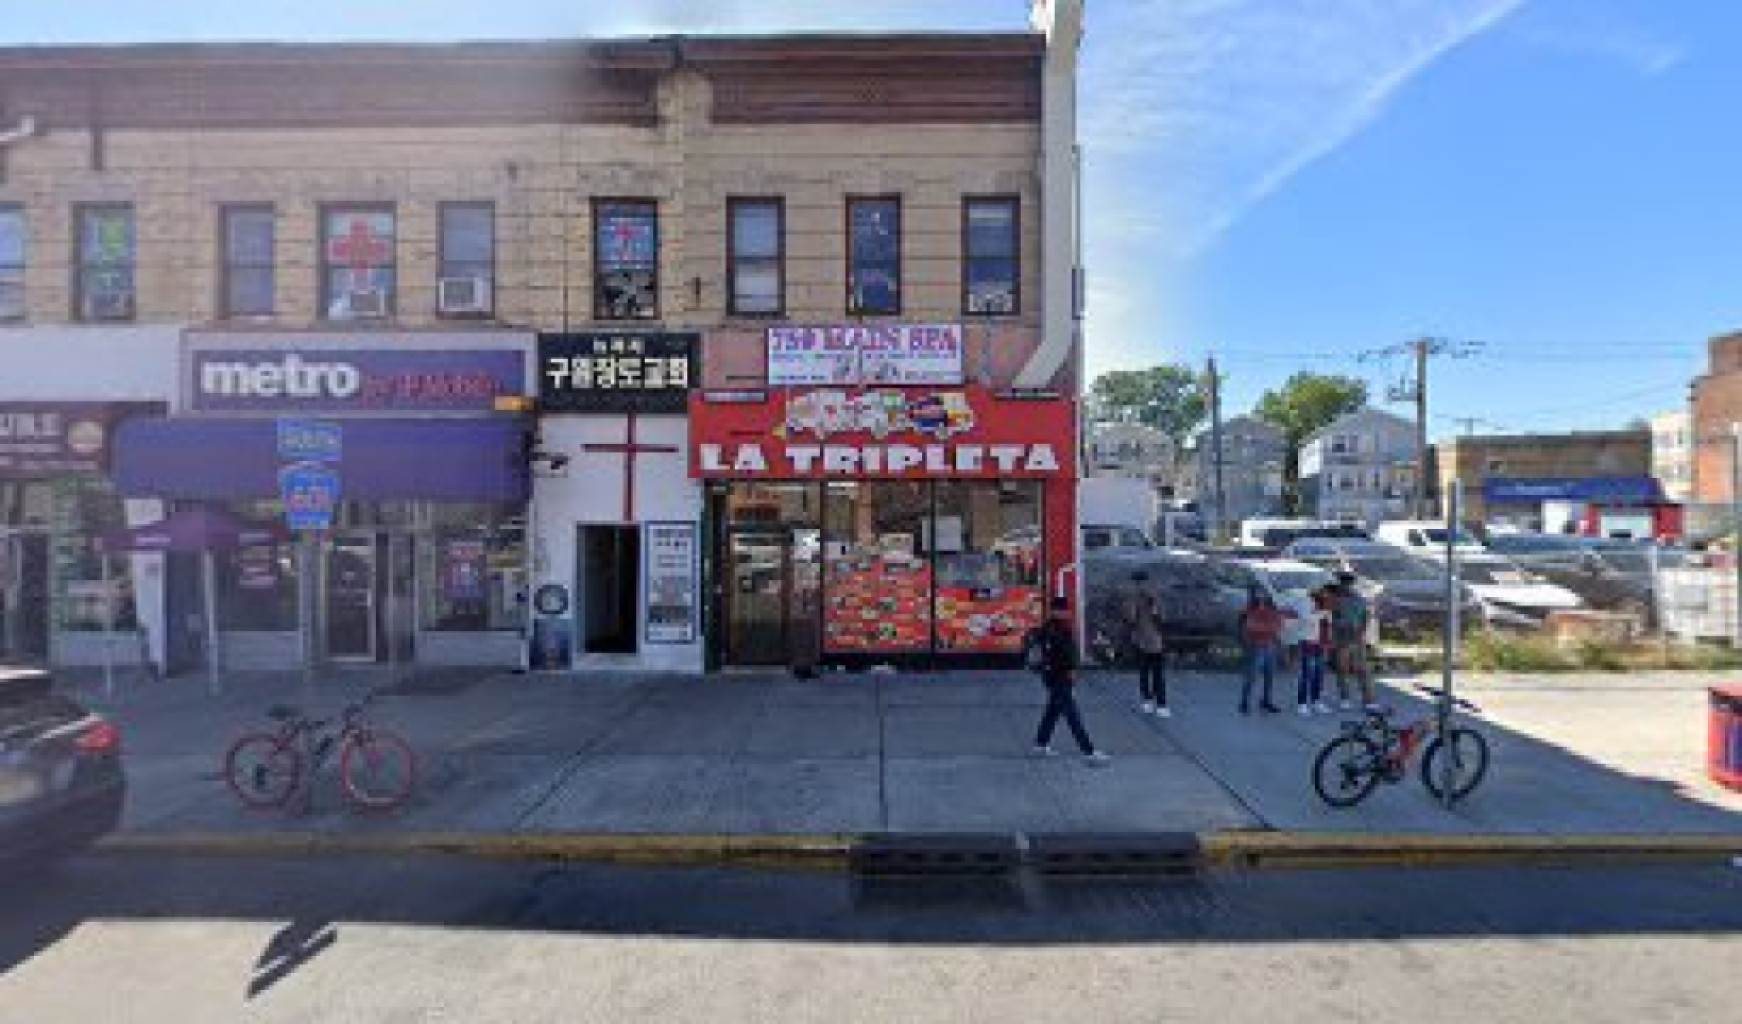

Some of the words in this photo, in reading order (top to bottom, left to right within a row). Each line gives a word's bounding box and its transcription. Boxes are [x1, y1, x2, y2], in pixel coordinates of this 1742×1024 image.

[203, 353, 359, 397] metro
[699, 444, 768, 471] LA
[785, 443, 1059, 473] TRIPLETA
